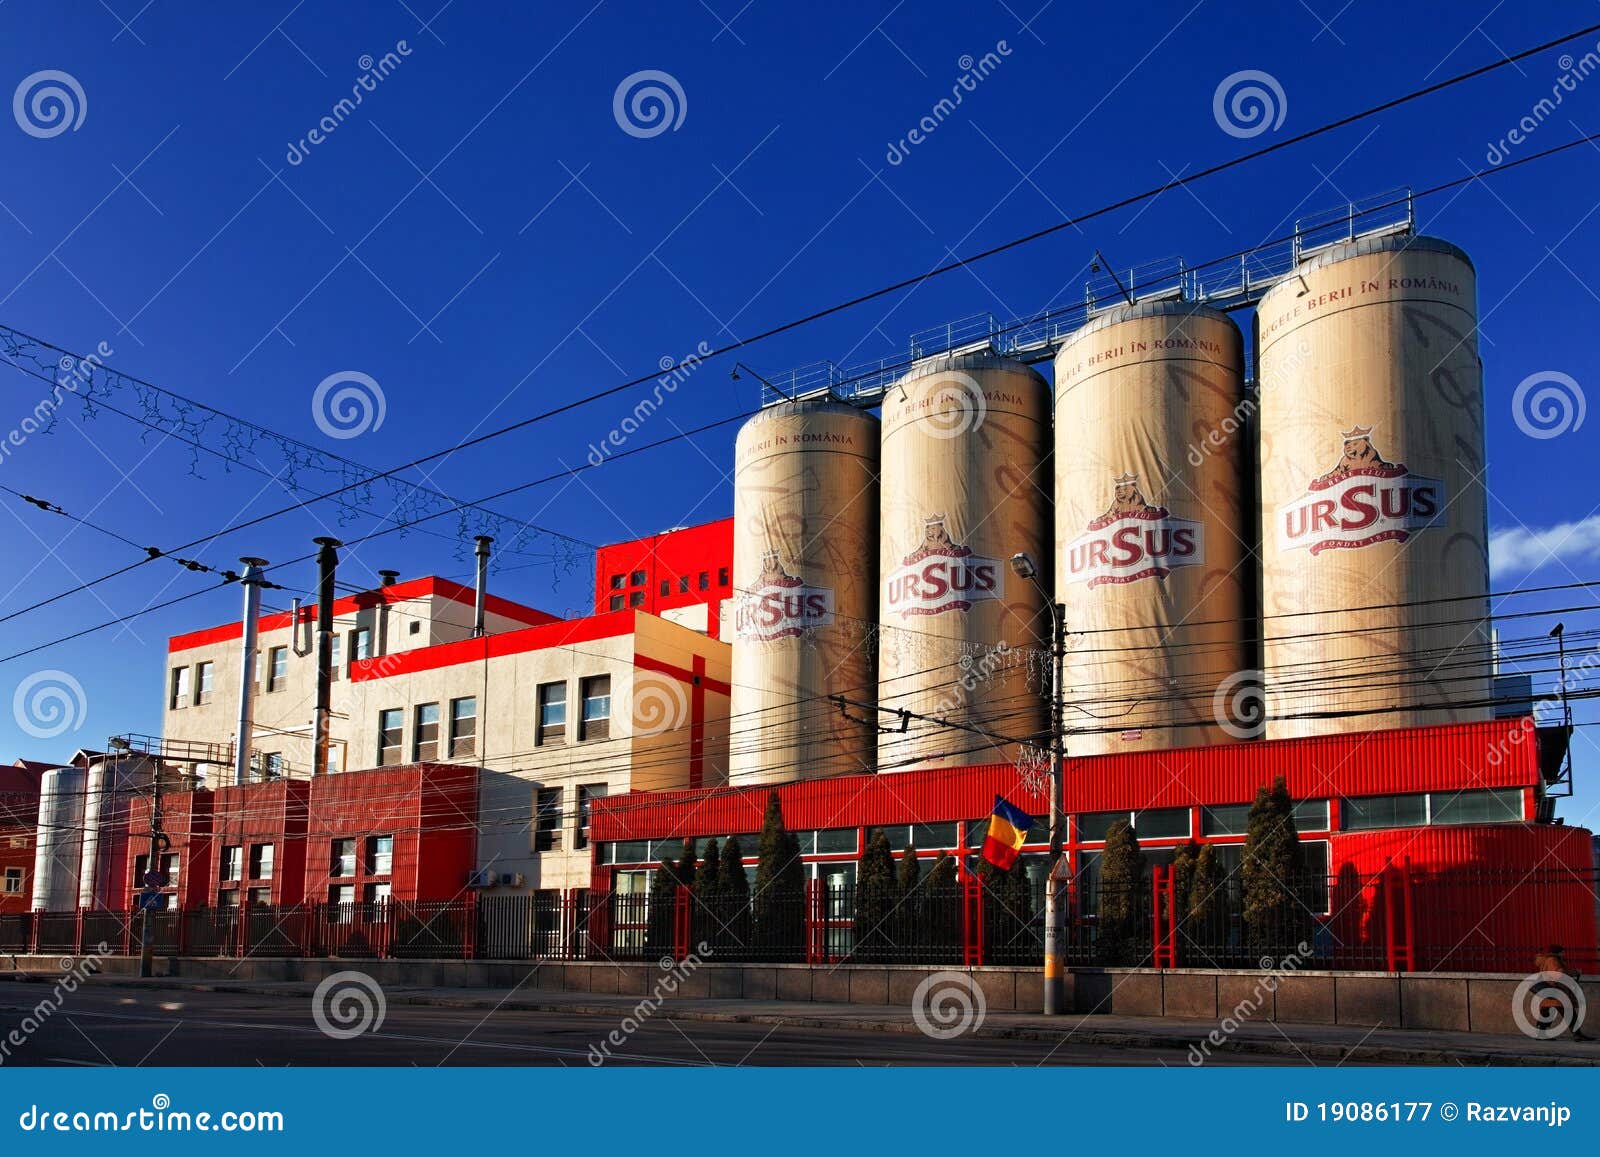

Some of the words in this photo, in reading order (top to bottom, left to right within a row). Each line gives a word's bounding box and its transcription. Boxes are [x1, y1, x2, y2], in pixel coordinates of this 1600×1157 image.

[1307, 286, 1352, 310] BERII
[1360, 280, 1380, 294] ÎN
[1388, 276, 1460, 296] ROMÂNIA
[1088, 346, 1125, 368] BERII
[1131, 341, 1148, 353] ÎN
[1154, 338, 1222, 354] ROMÂNIA
[1285, 484, 1436, 539] URSUS
[1070, 525, 1196, 574] URSUS
[888, 562, 997, 605] URSUS
